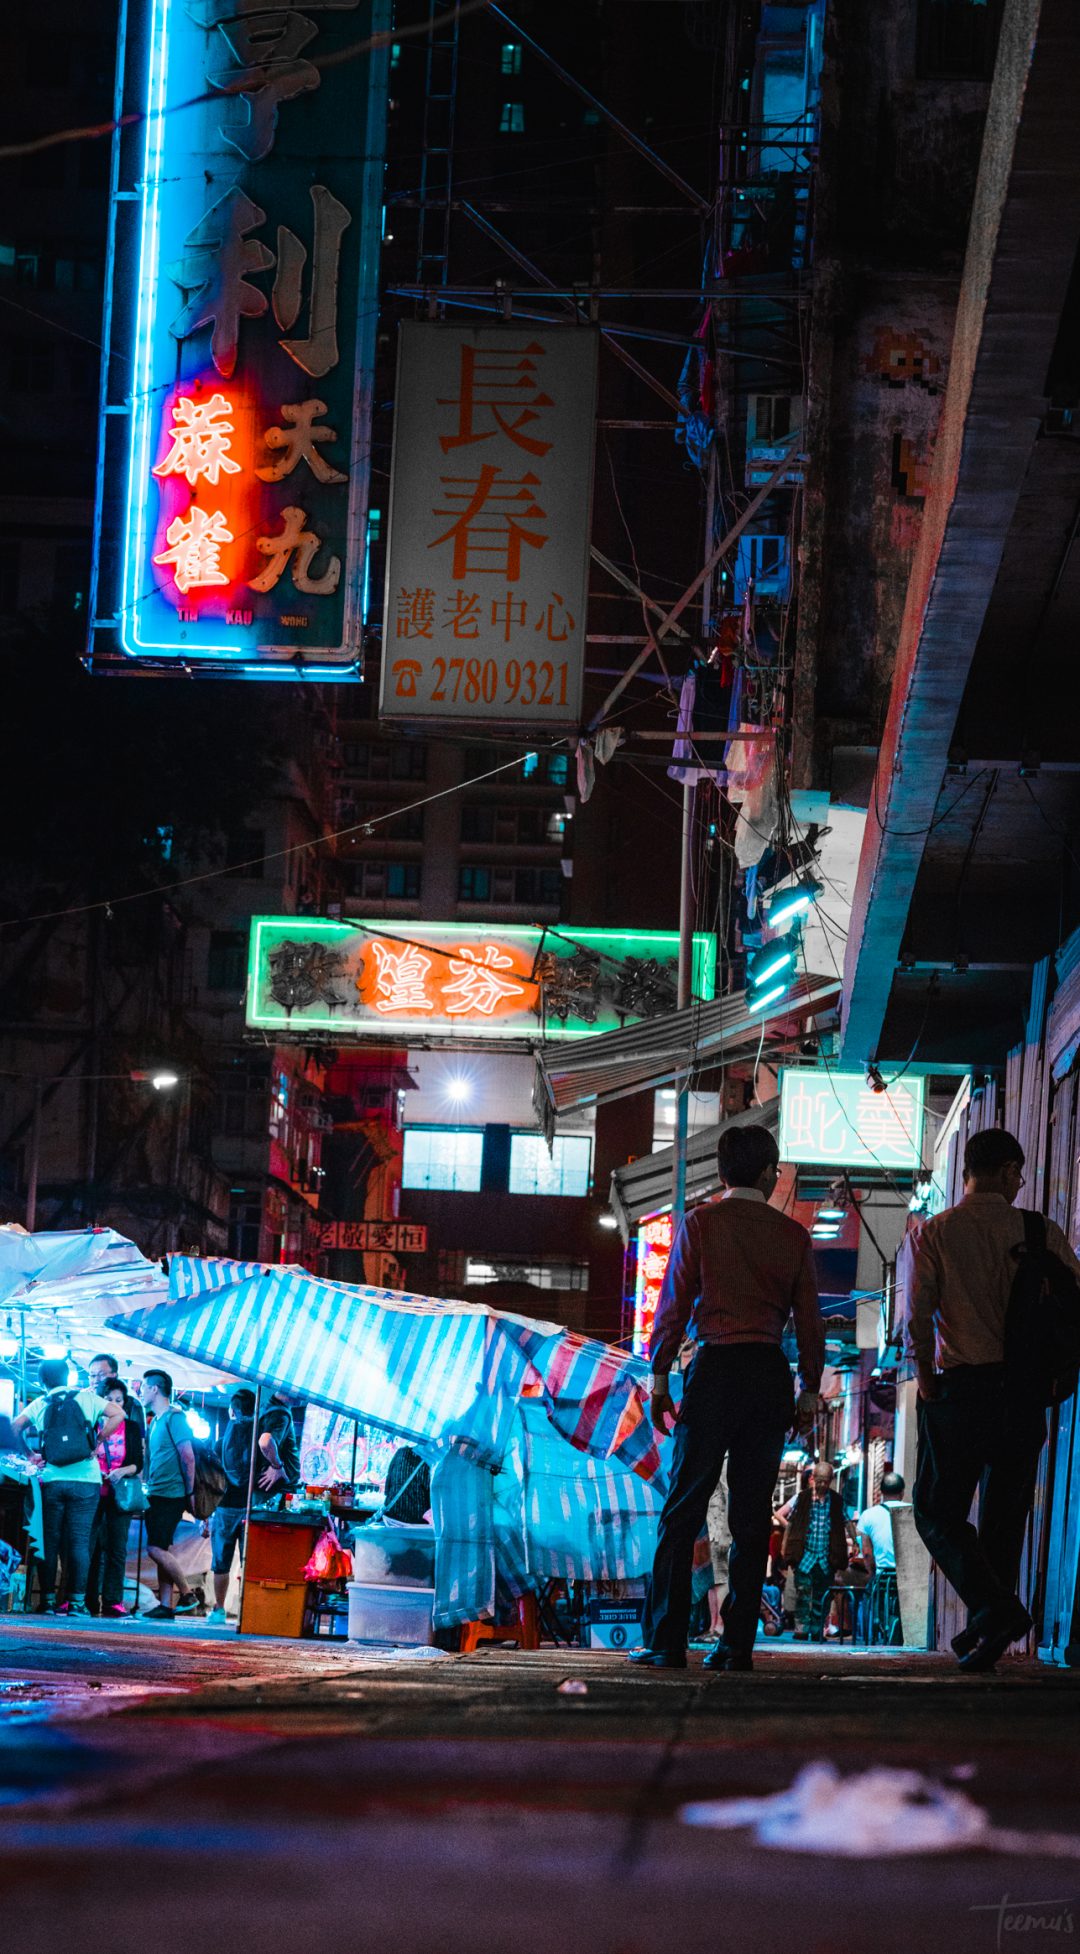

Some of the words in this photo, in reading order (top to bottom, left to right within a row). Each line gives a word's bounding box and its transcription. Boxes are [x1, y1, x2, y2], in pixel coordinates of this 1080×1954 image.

[427, 341, 556, 582] 長春
[247, 399, 349, 595] 天九
[225, 609, 253, 625] KAU
[396, 587, 576, 642] 護老中心
[430, 657, 498, 704] 2780
[504, 659, 570, 706] 9321
[786, 1080, 914, 1159] 蛇羹
